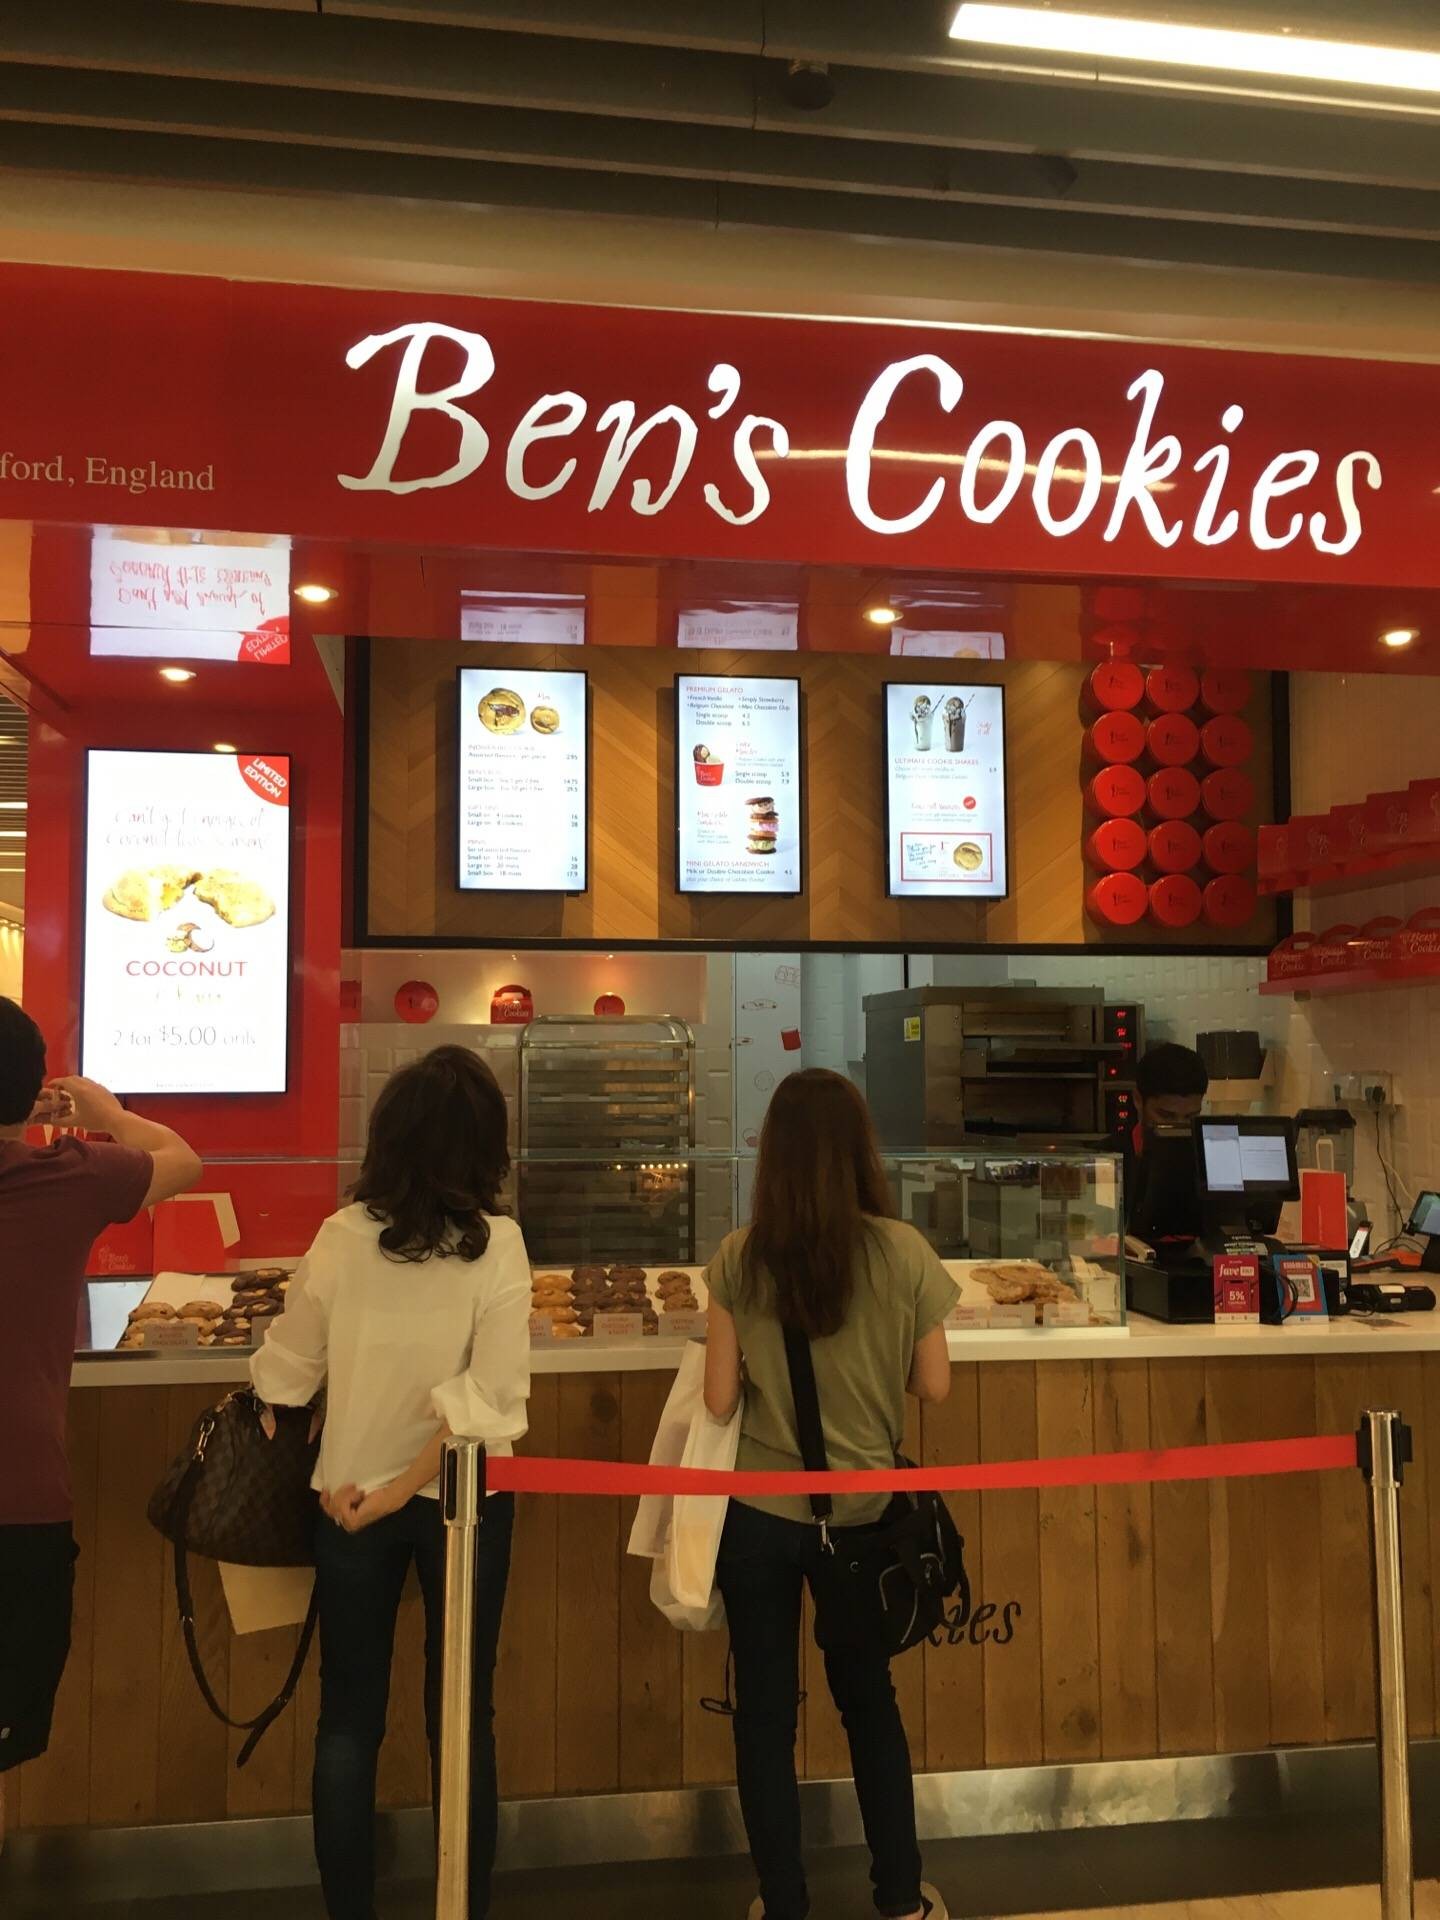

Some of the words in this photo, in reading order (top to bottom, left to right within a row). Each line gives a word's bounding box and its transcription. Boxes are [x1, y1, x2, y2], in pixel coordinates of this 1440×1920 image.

[337, 322, 790, 526] Ben's
[844, 352, 1382, 556] Cookies
[85, 456, 216, 495] England
[244, 765, 282, 798] EDITION
[252, 758, 287, 788] LIMITED
[125, 960, 249, 977] COCONUT
[1219, 1264, 1240, 1278] fave
[1229, 1290, 1246, 1301] 5%
